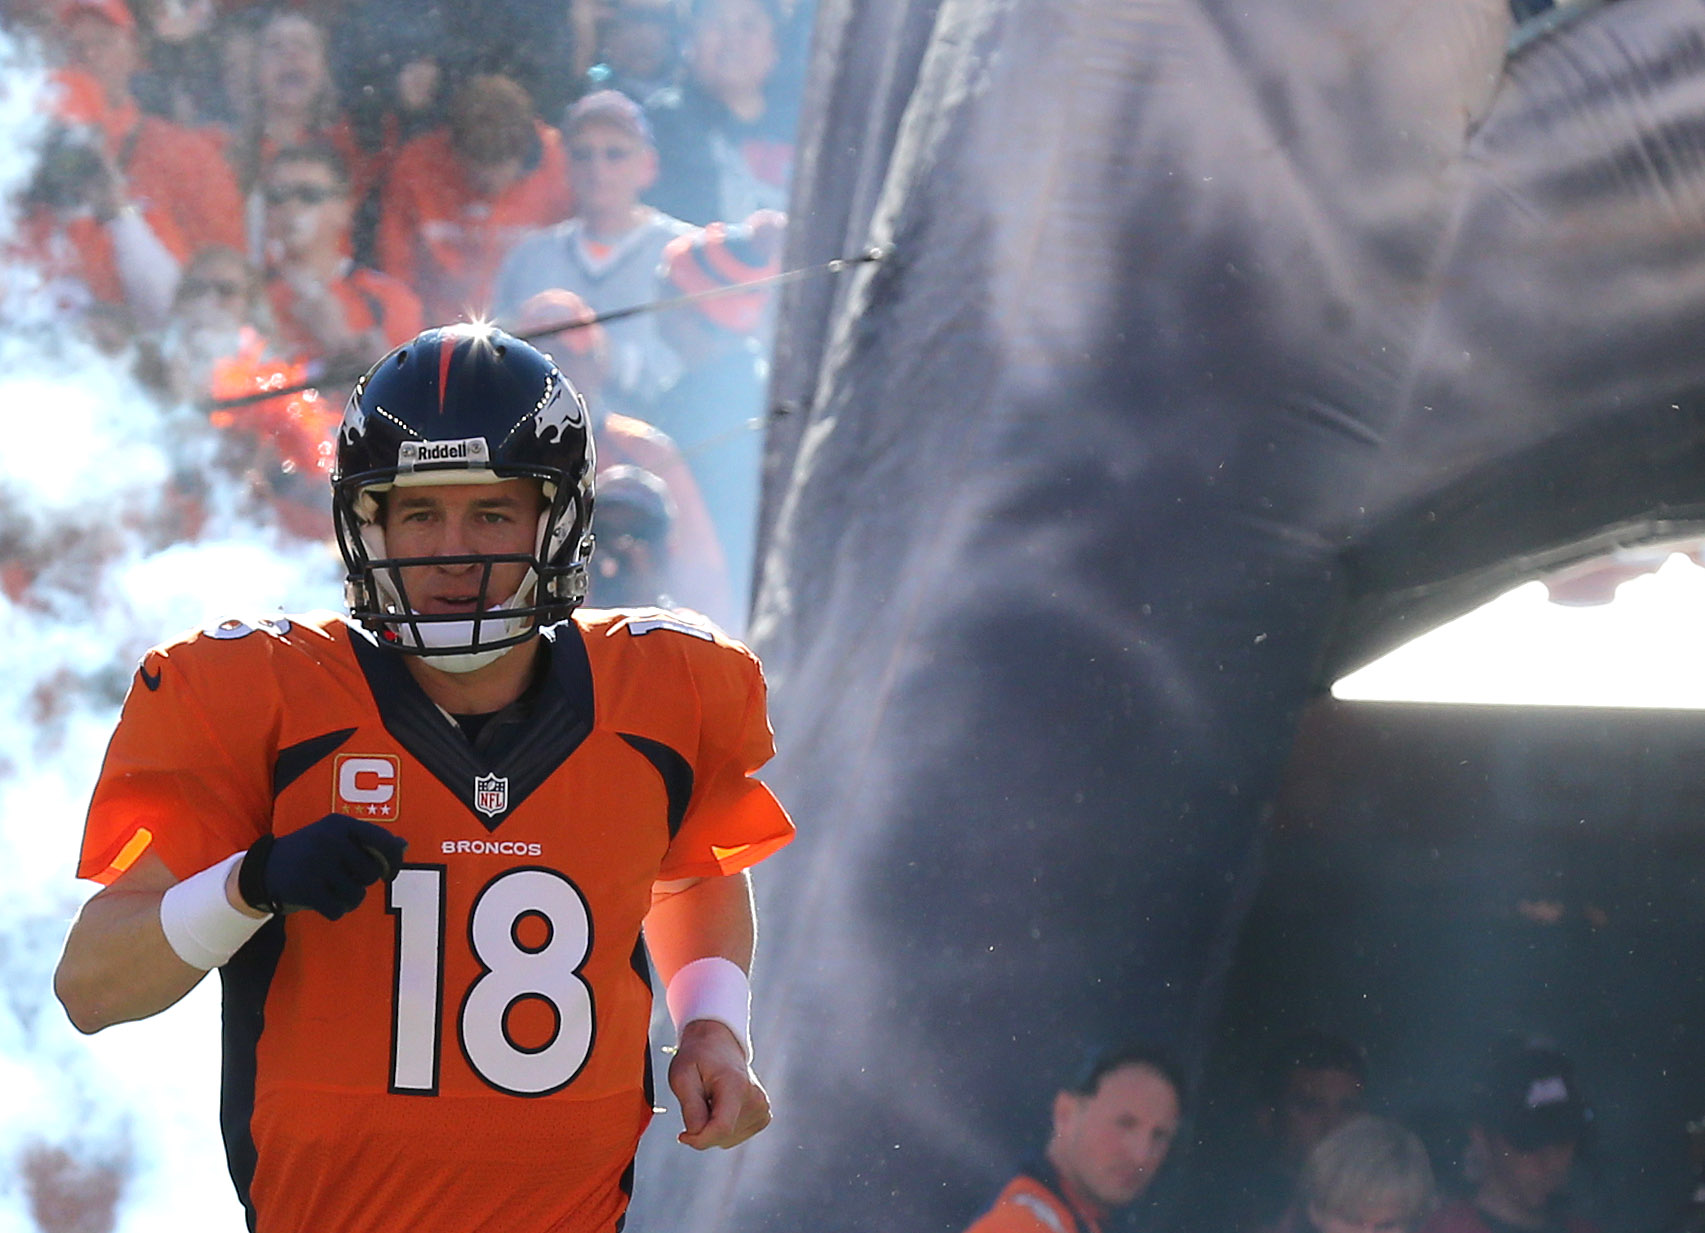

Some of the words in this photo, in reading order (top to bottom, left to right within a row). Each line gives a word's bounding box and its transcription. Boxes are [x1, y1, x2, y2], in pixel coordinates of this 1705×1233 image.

[417, 442, 467, 461] Riddell
[338, 757, 395, 804] C
[479, 791, 503, 809] NFL
[440, 839, 543, 857] BRONCOS
[385, 861, 597, 1099] 18
